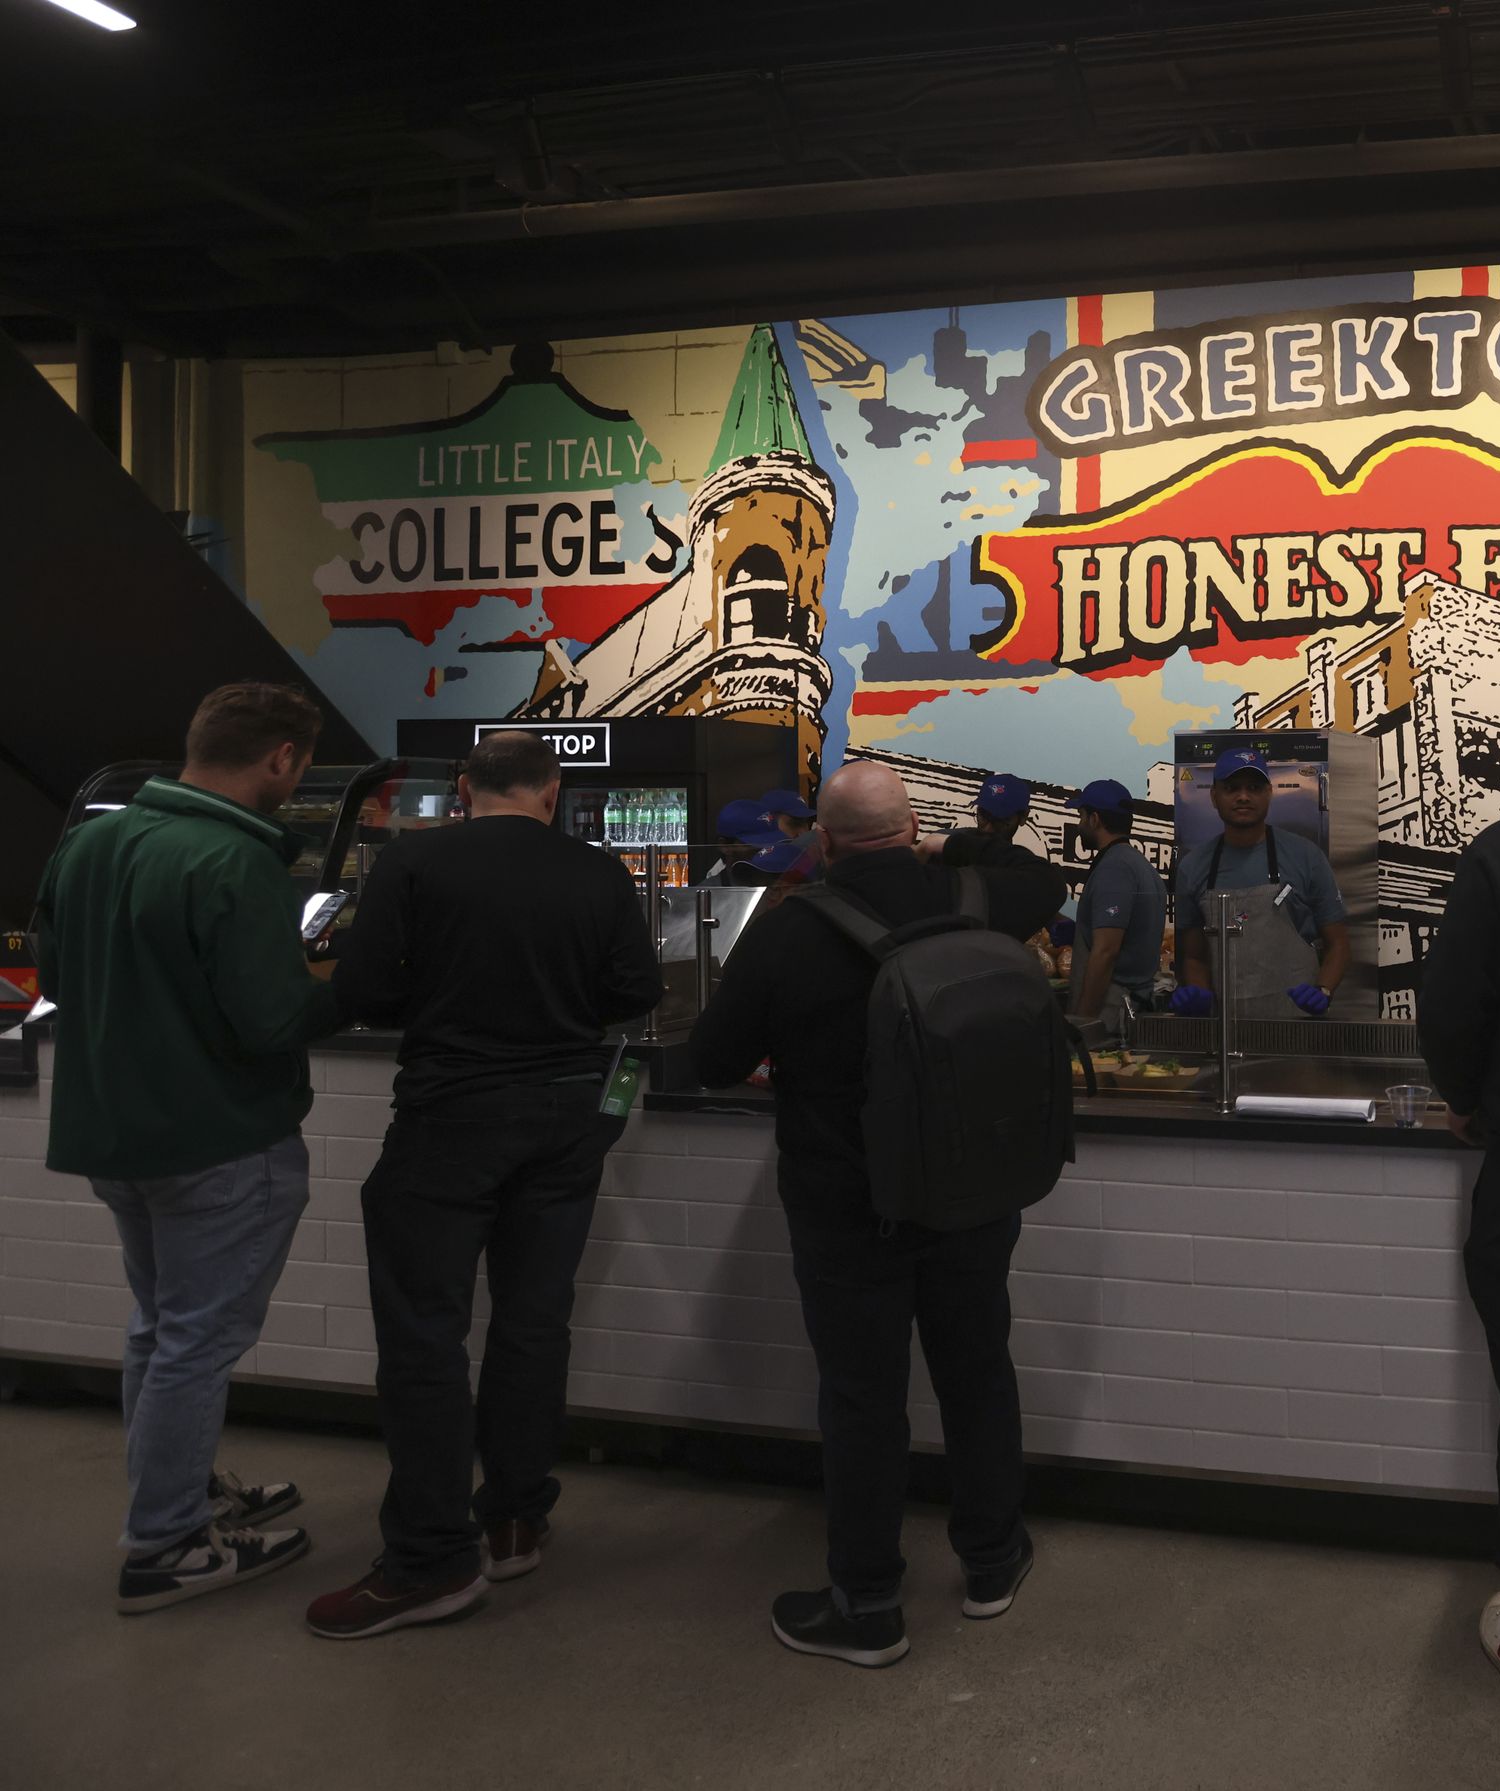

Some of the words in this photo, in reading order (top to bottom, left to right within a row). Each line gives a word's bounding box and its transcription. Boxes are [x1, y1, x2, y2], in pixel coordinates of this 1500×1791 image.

[418, 442, 532, 487] LITTLE
[547, 435, 649, 481] ITALY
[349, 501, 626, 584] COLLEGE
[1055, 529, 1426, 664] HONEST
[541, 734, 597, 755] TOP
